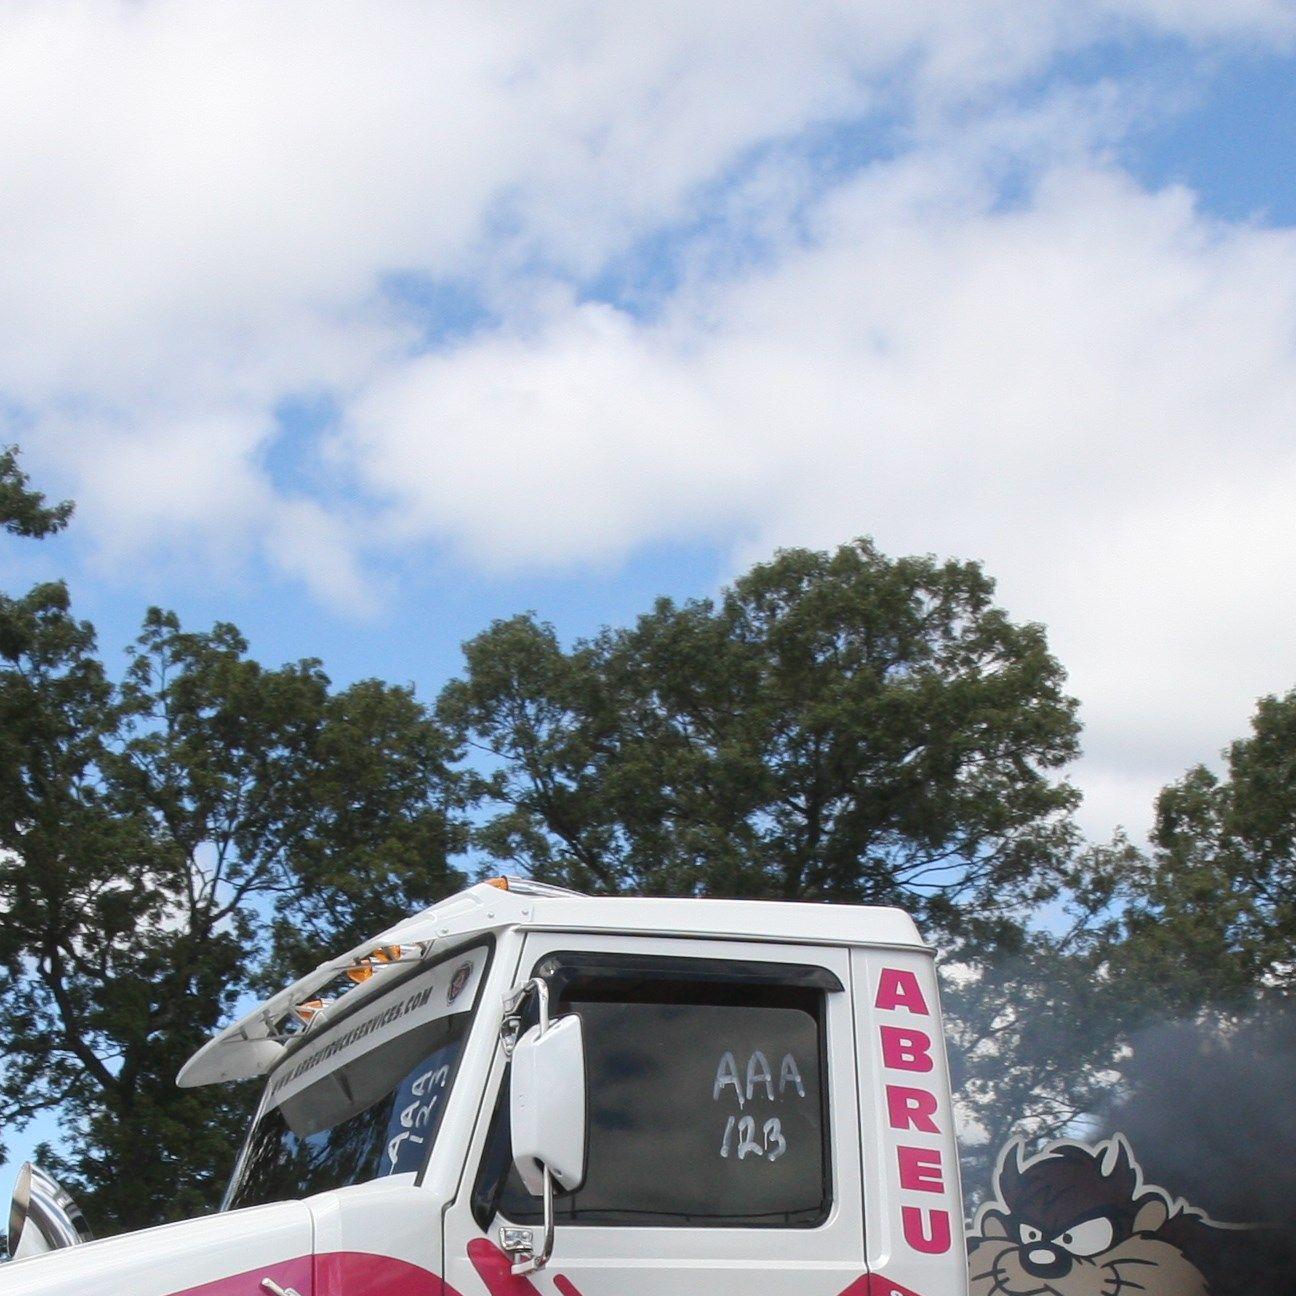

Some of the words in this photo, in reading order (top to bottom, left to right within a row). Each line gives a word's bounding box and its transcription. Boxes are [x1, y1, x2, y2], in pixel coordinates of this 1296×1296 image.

[712, 1050, 806, 1110] AAA
[874, 967, 952, 1255] ABREU
[387, 1070, 434, 1175] AAA
[719, 1115, 787, 1161] 123
